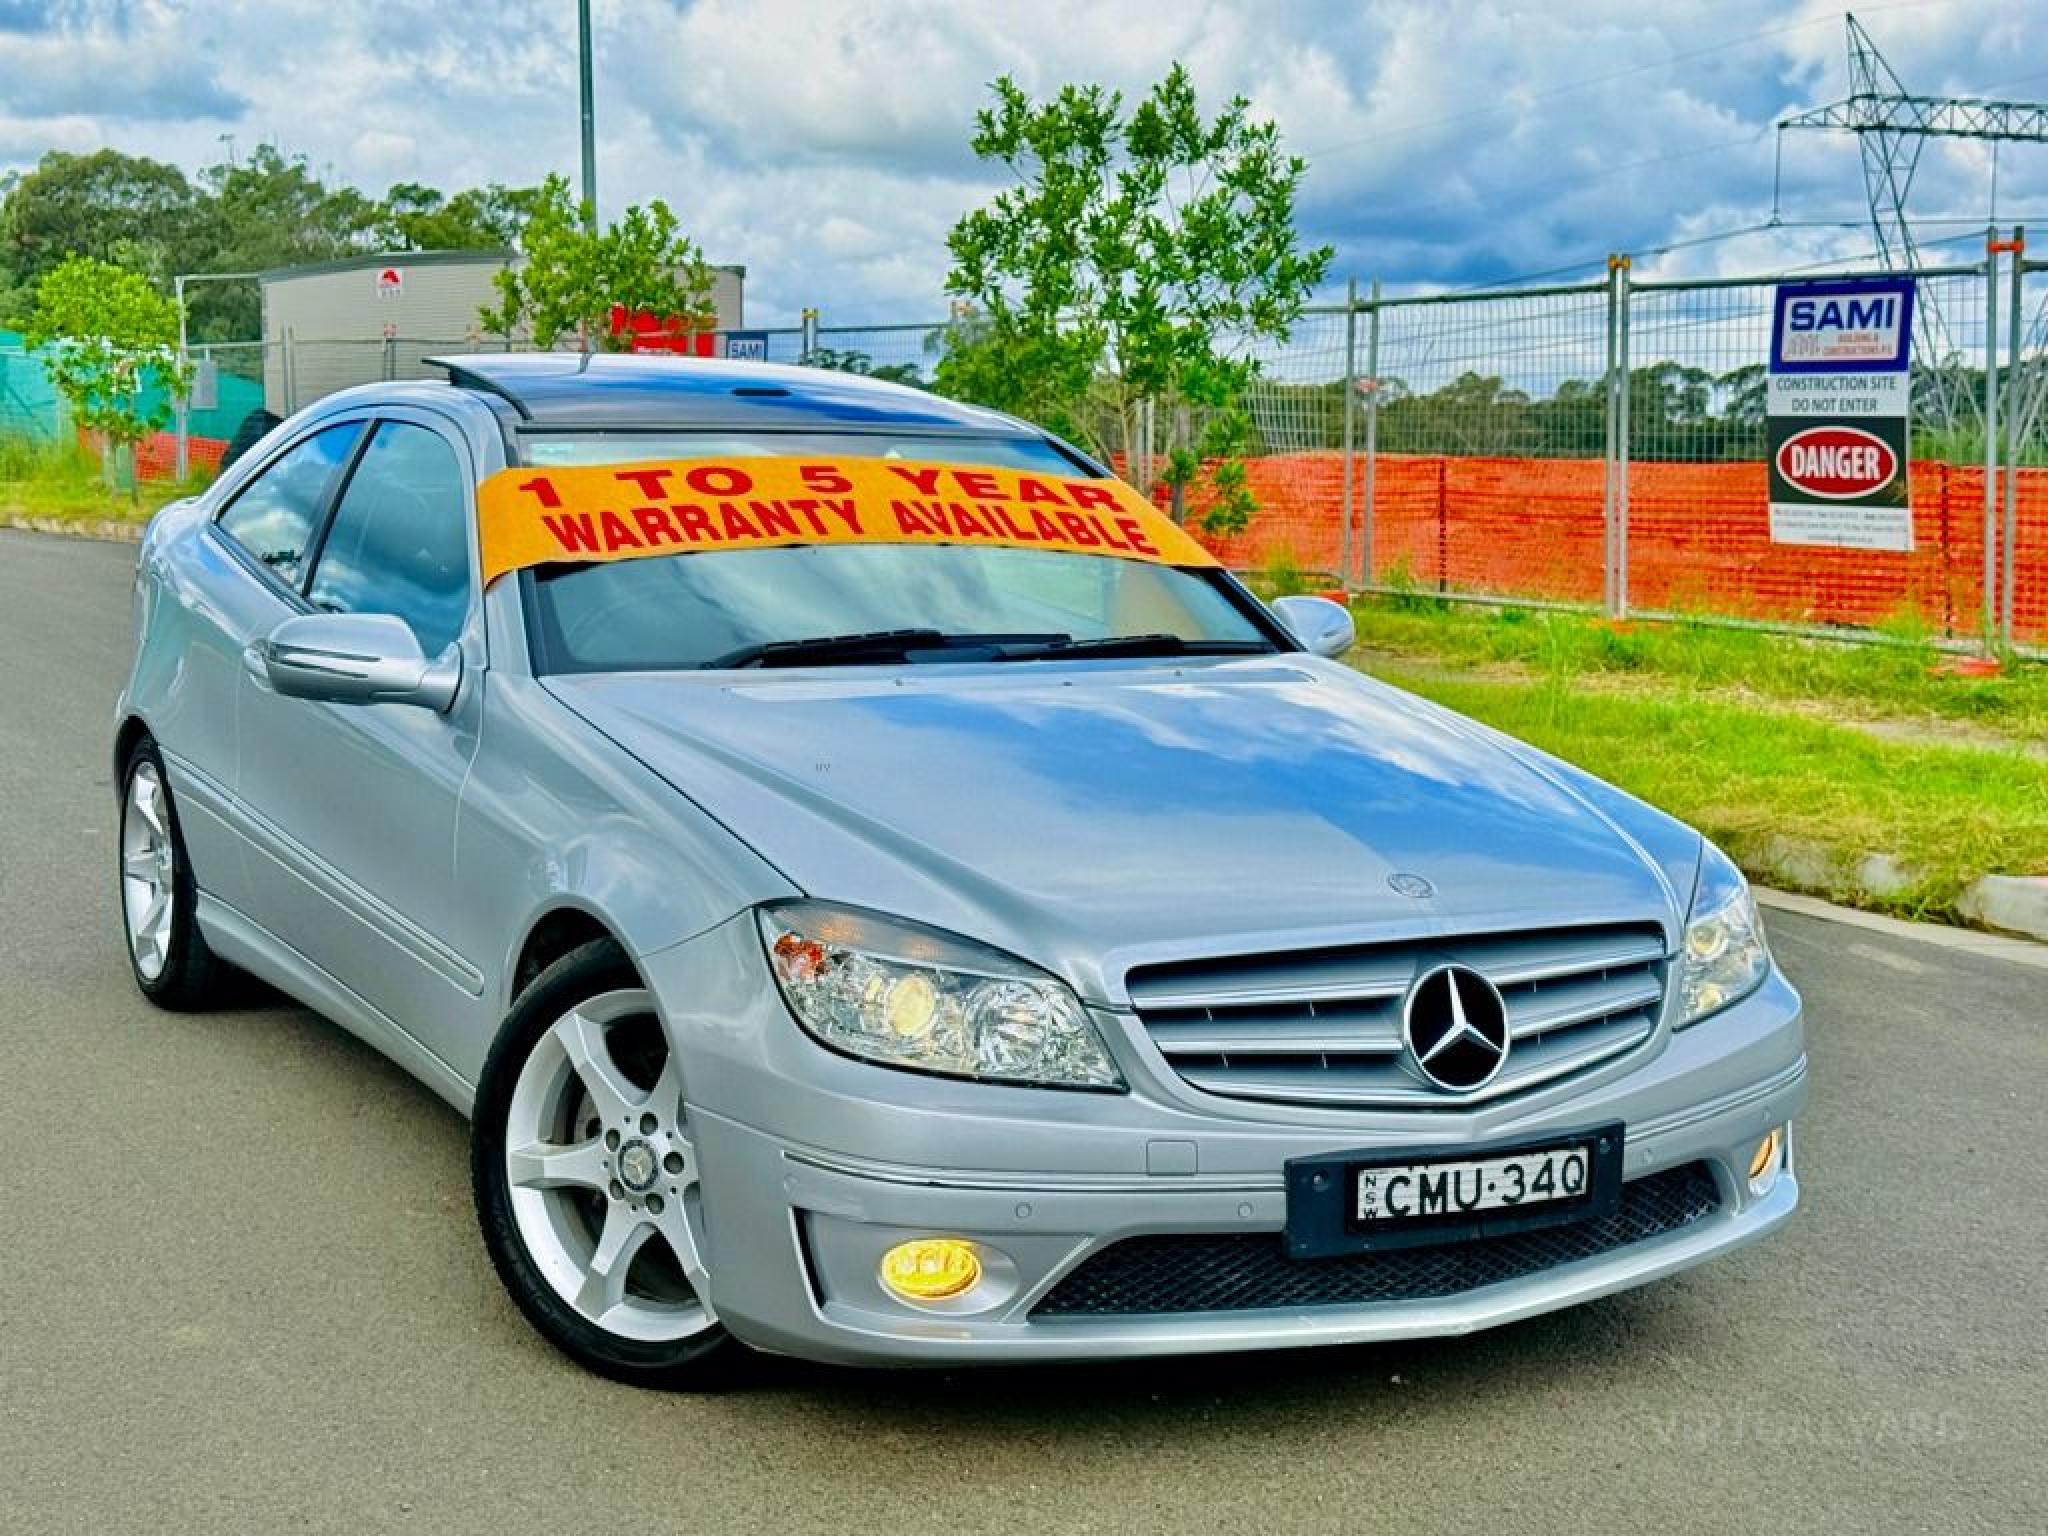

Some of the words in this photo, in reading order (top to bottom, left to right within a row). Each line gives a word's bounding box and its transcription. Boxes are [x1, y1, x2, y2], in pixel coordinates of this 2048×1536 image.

[1790, 298, 1895, 331] SAMI
[1776, 376, 1867, 390] CONSTRUCTION
[1871, 375, 1897, 390] SITE
[1791, 397, 1809, 412] DO
[1811, 397, 1836, 412] NOT
[1839, 397, 1878, 412] ENTER
[1790, 445, 1881, 480] DANGER
[519, 477, 562, 508] 1
[615, 469, 753, 499] TO
[799, 466, 853, 493] 5
[887, 466, 1128, 512] YEAR
[541, 500, 865, 552] WARRANTY
[891, 500, 1160, 555] AVAILABLE
